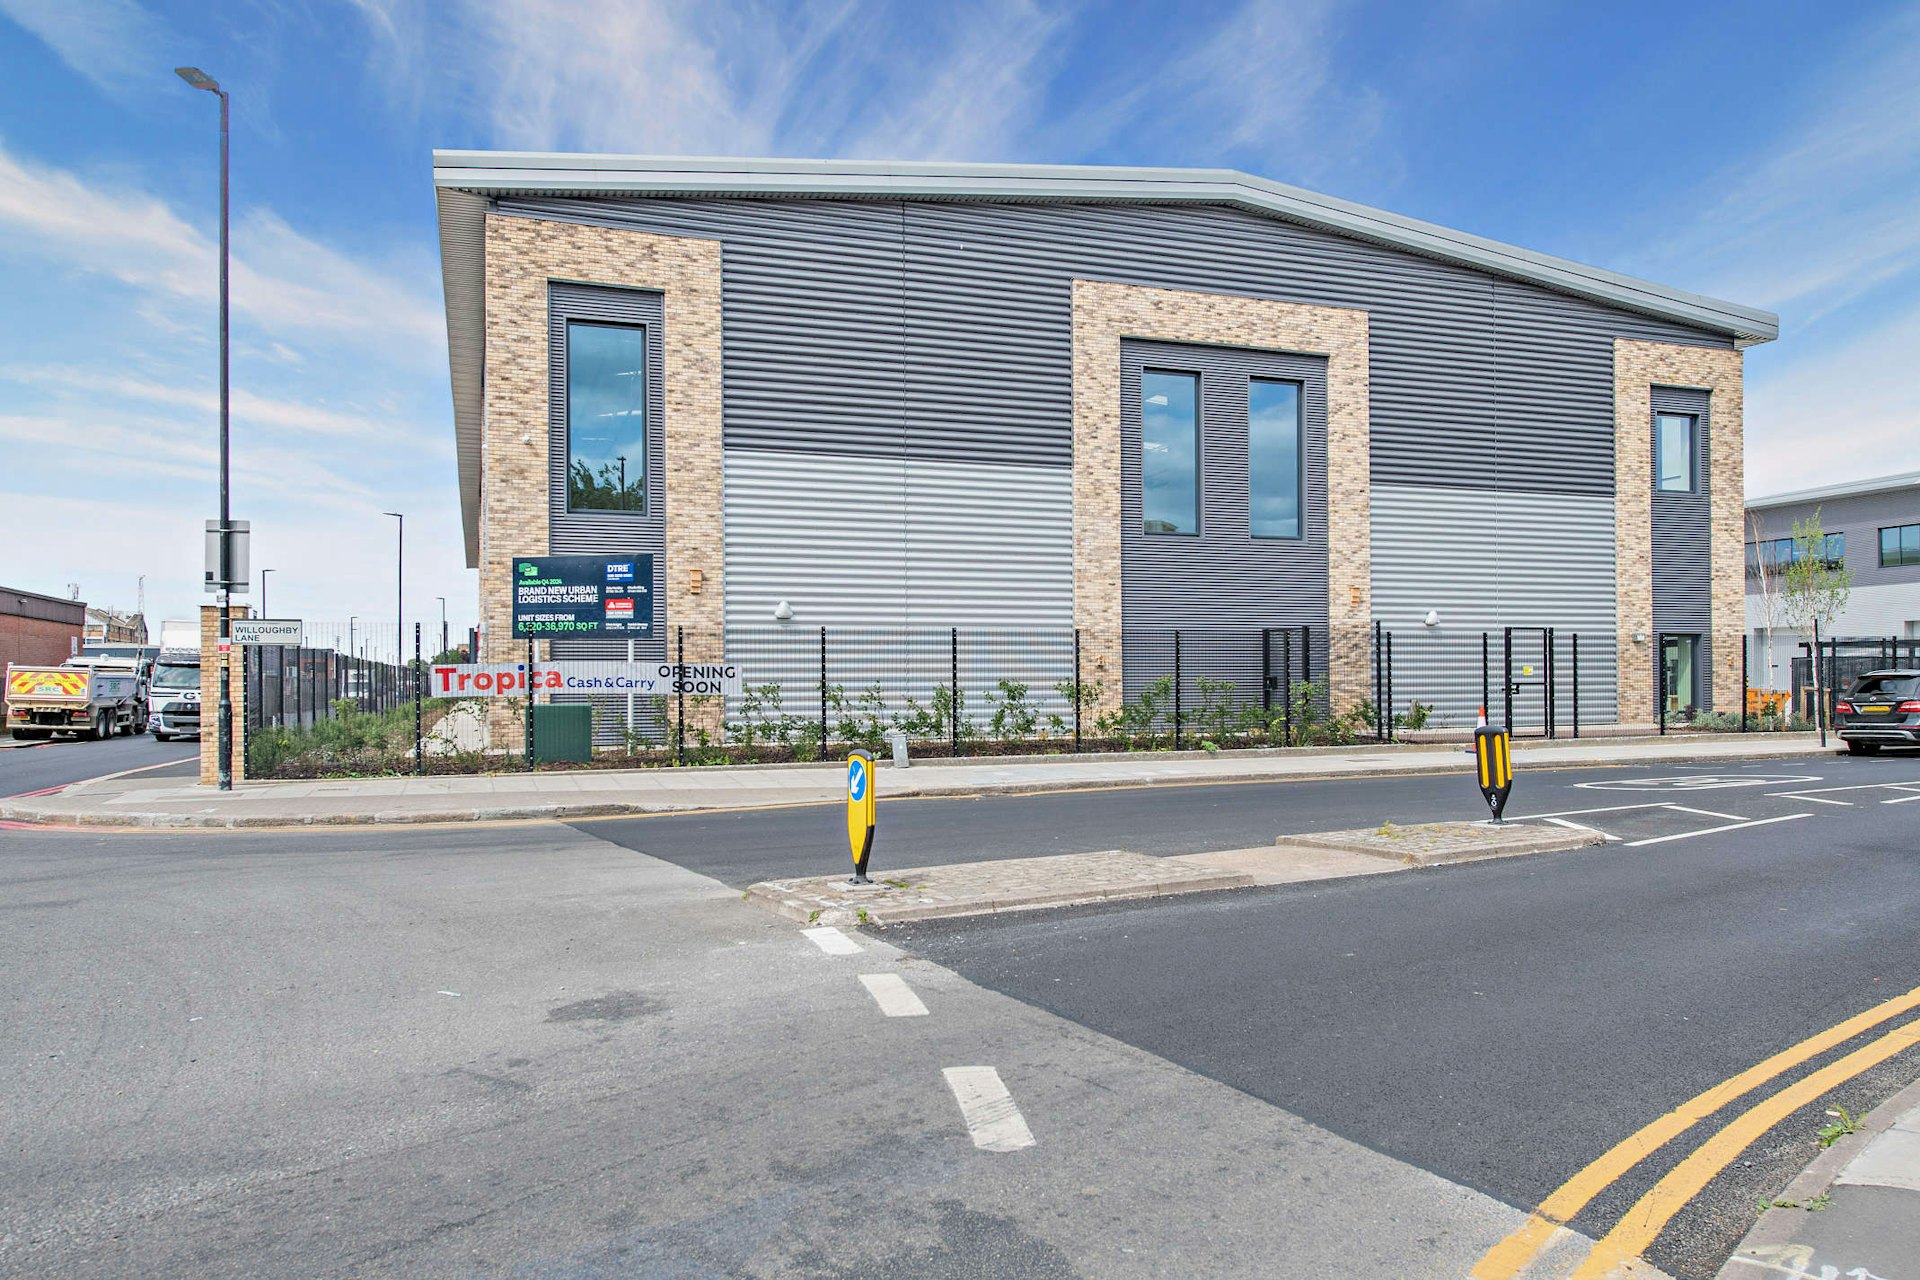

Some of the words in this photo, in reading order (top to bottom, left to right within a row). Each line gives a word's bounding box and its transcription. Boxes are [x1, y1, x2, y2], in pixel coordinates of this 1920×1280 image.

[607, 564, 629, 573] DTRE
[518, 586, 547, 596] BRAND
[548, 586, 567, 595] NEW
[568, 585, 598, 594] URBAN
[518, 595, 561, 604] LOGISTICS
[562, 594, 599, 603] SCHEME
[517, 614, 534, 622] UNIT
[535, 614, 554, 622] SIZES
[554, 613, 575, 621] FROM
[235, 626, 298, 634] WILLOUGHBY
[575, 622, 588, 631] SQ
[588, 622, 599, 630] FT
[235, 634, 260, 642] LANE
[658, 665, 736, 679] OPENING
[435, 664, 563, 694] Tropica
[672, 680, 721, 693] SOON
